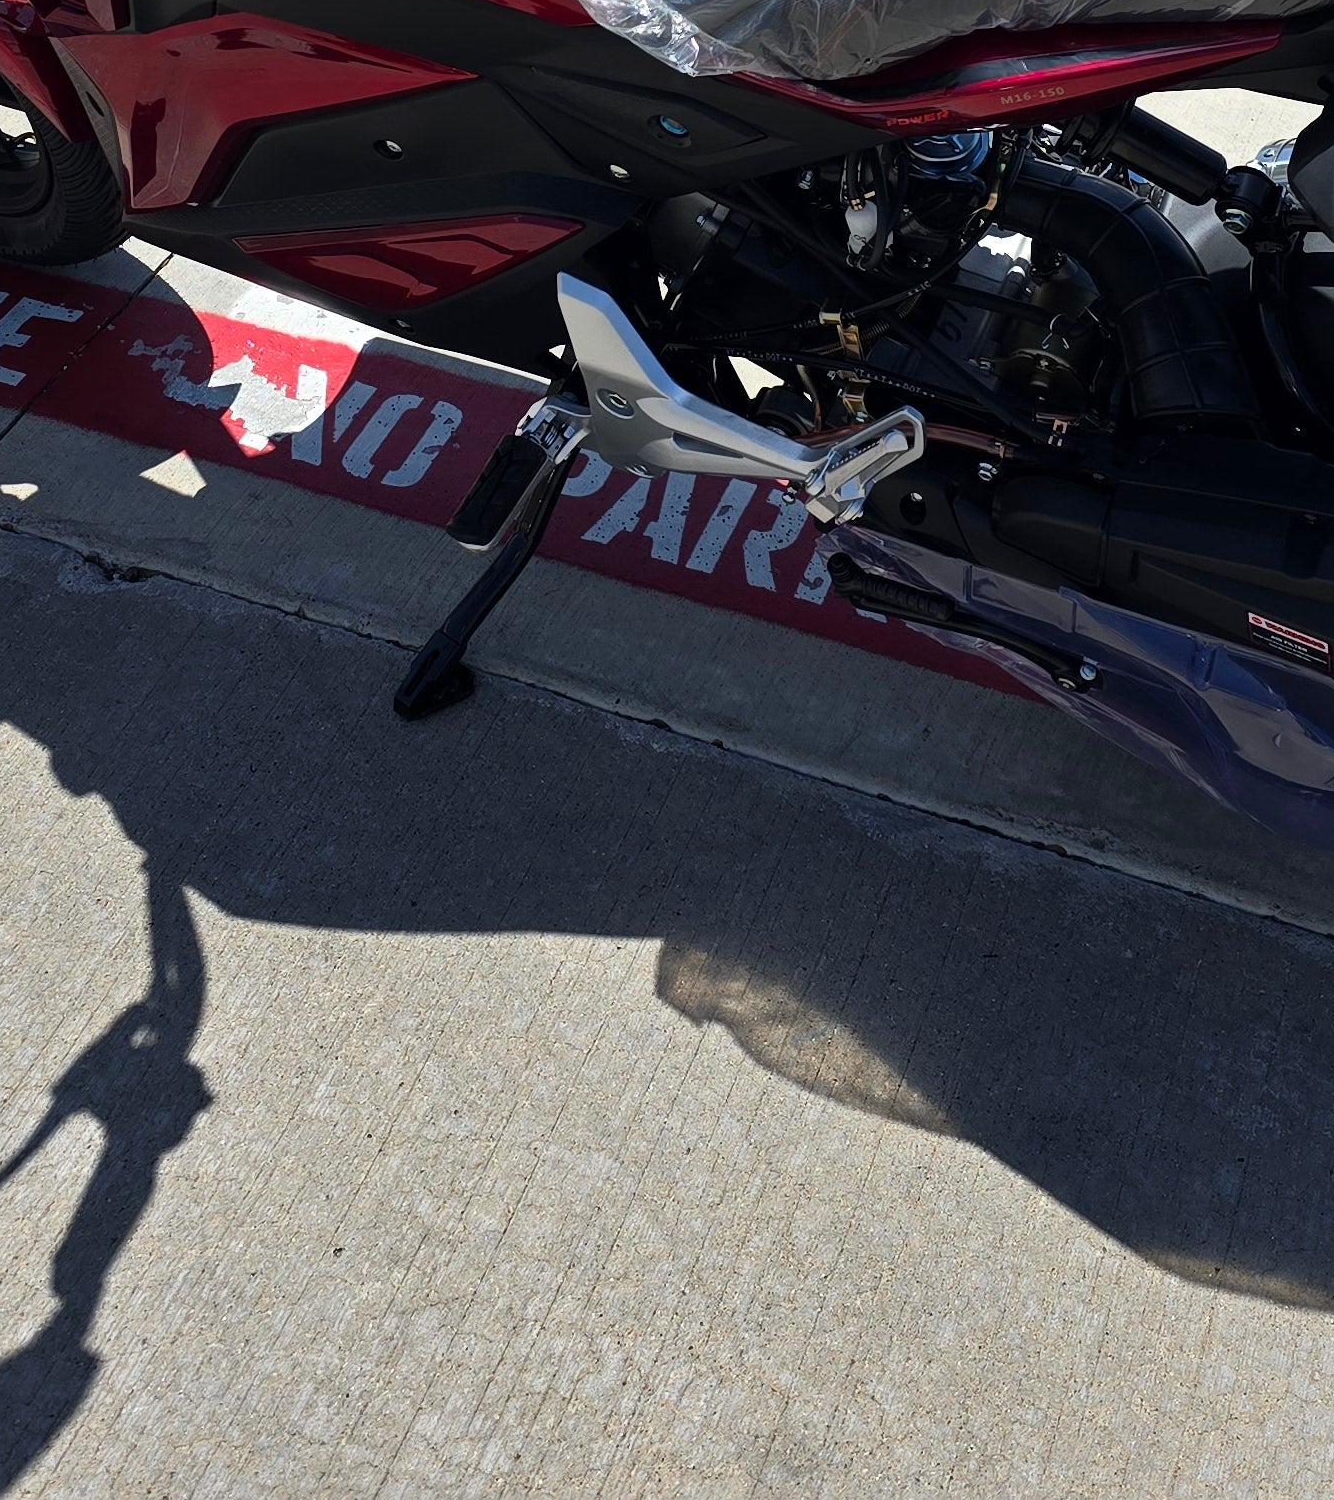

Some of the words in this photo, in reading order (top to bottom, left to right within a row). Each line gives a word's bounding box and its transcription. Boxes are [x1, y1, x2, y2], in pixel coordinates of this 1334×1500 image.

[1000, 86, 1065, 105] M16-150
[885, 109, 950, 127] POWER
[238, 364, 464, 488] NO
